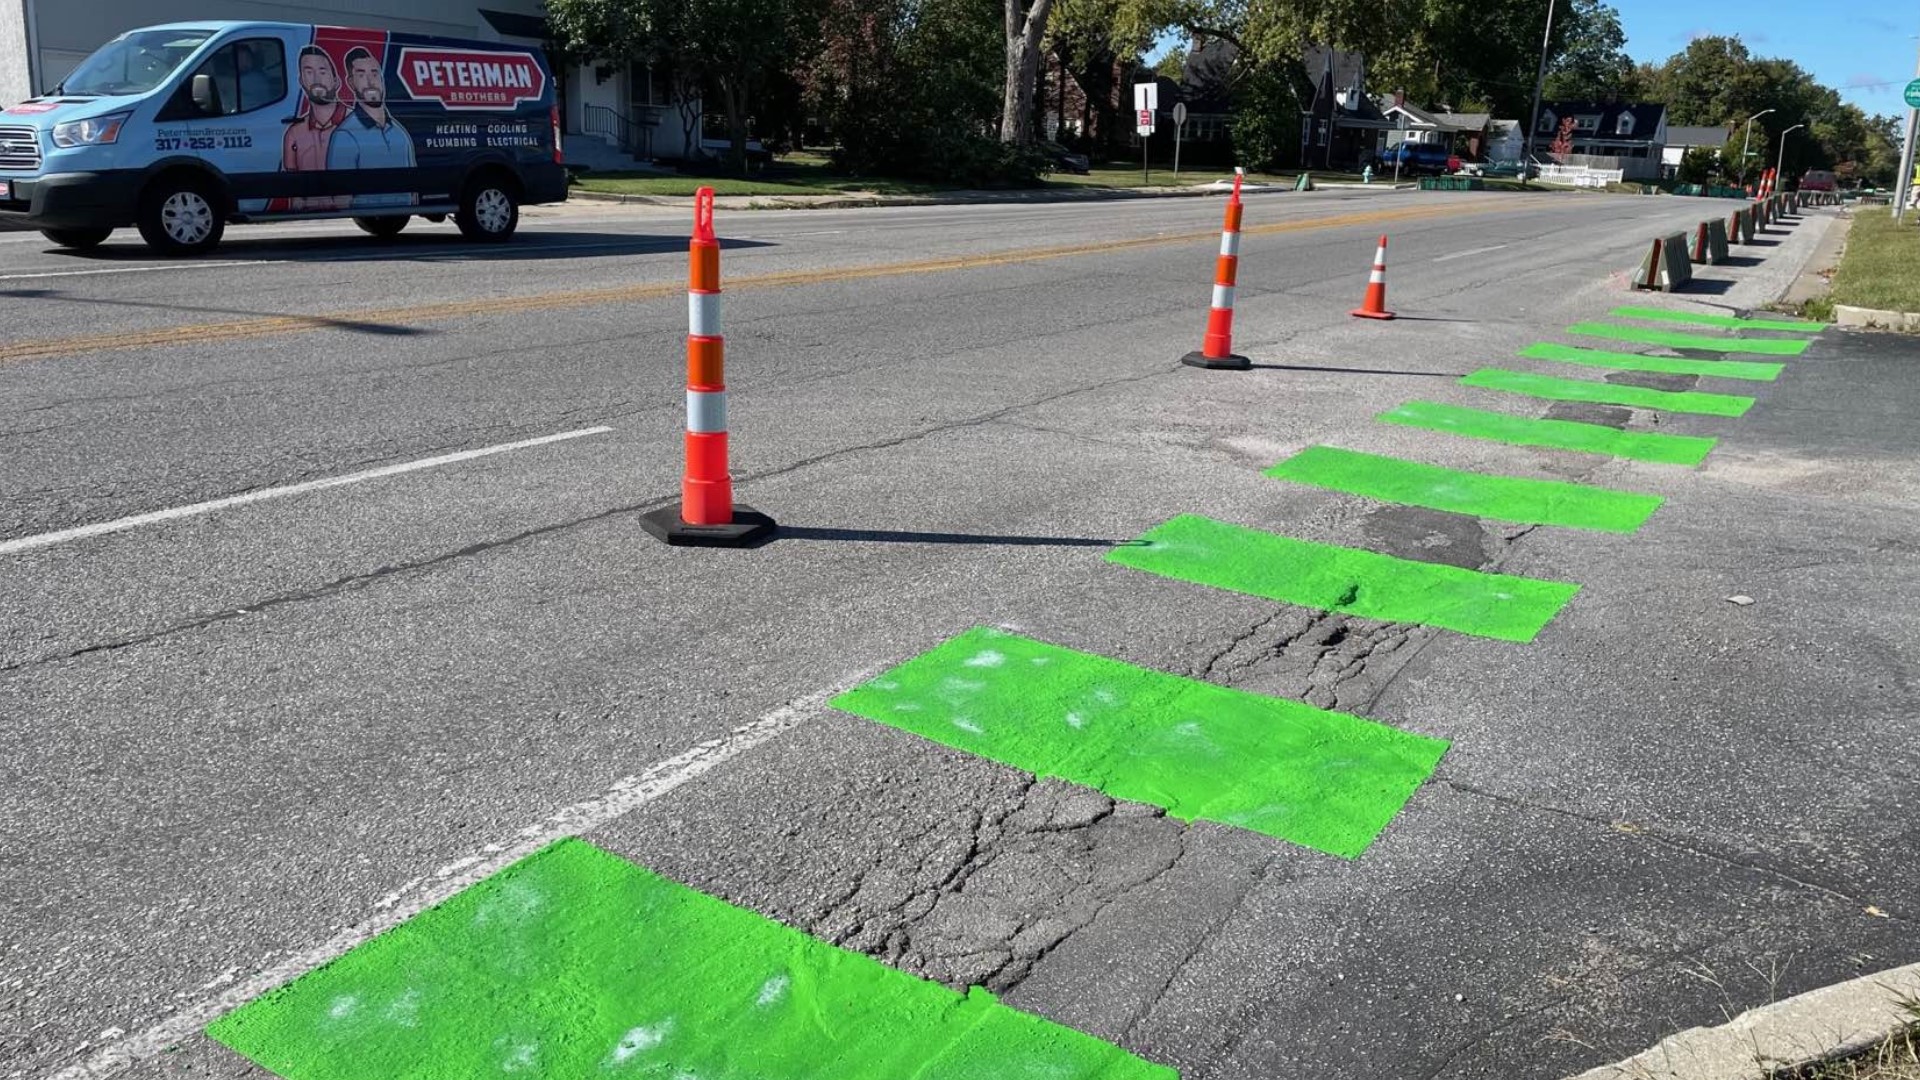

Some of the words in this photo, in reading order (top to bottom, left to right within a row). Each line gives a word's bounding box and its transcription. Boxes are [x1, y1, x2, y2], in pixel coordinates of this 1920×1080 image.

[412, 60, 533, 88] PETERMAN
[450, 91, 507, 102] BROTHERS
[157, 128, 247, 138] PetermanBros.com
[436, 124, 478, 134] HEATING
[487, 124, 528, 134] COOLING
[426, 138, 478, 148] PLUMBING
[487, 137, 539, 147] ELECTRICAL
